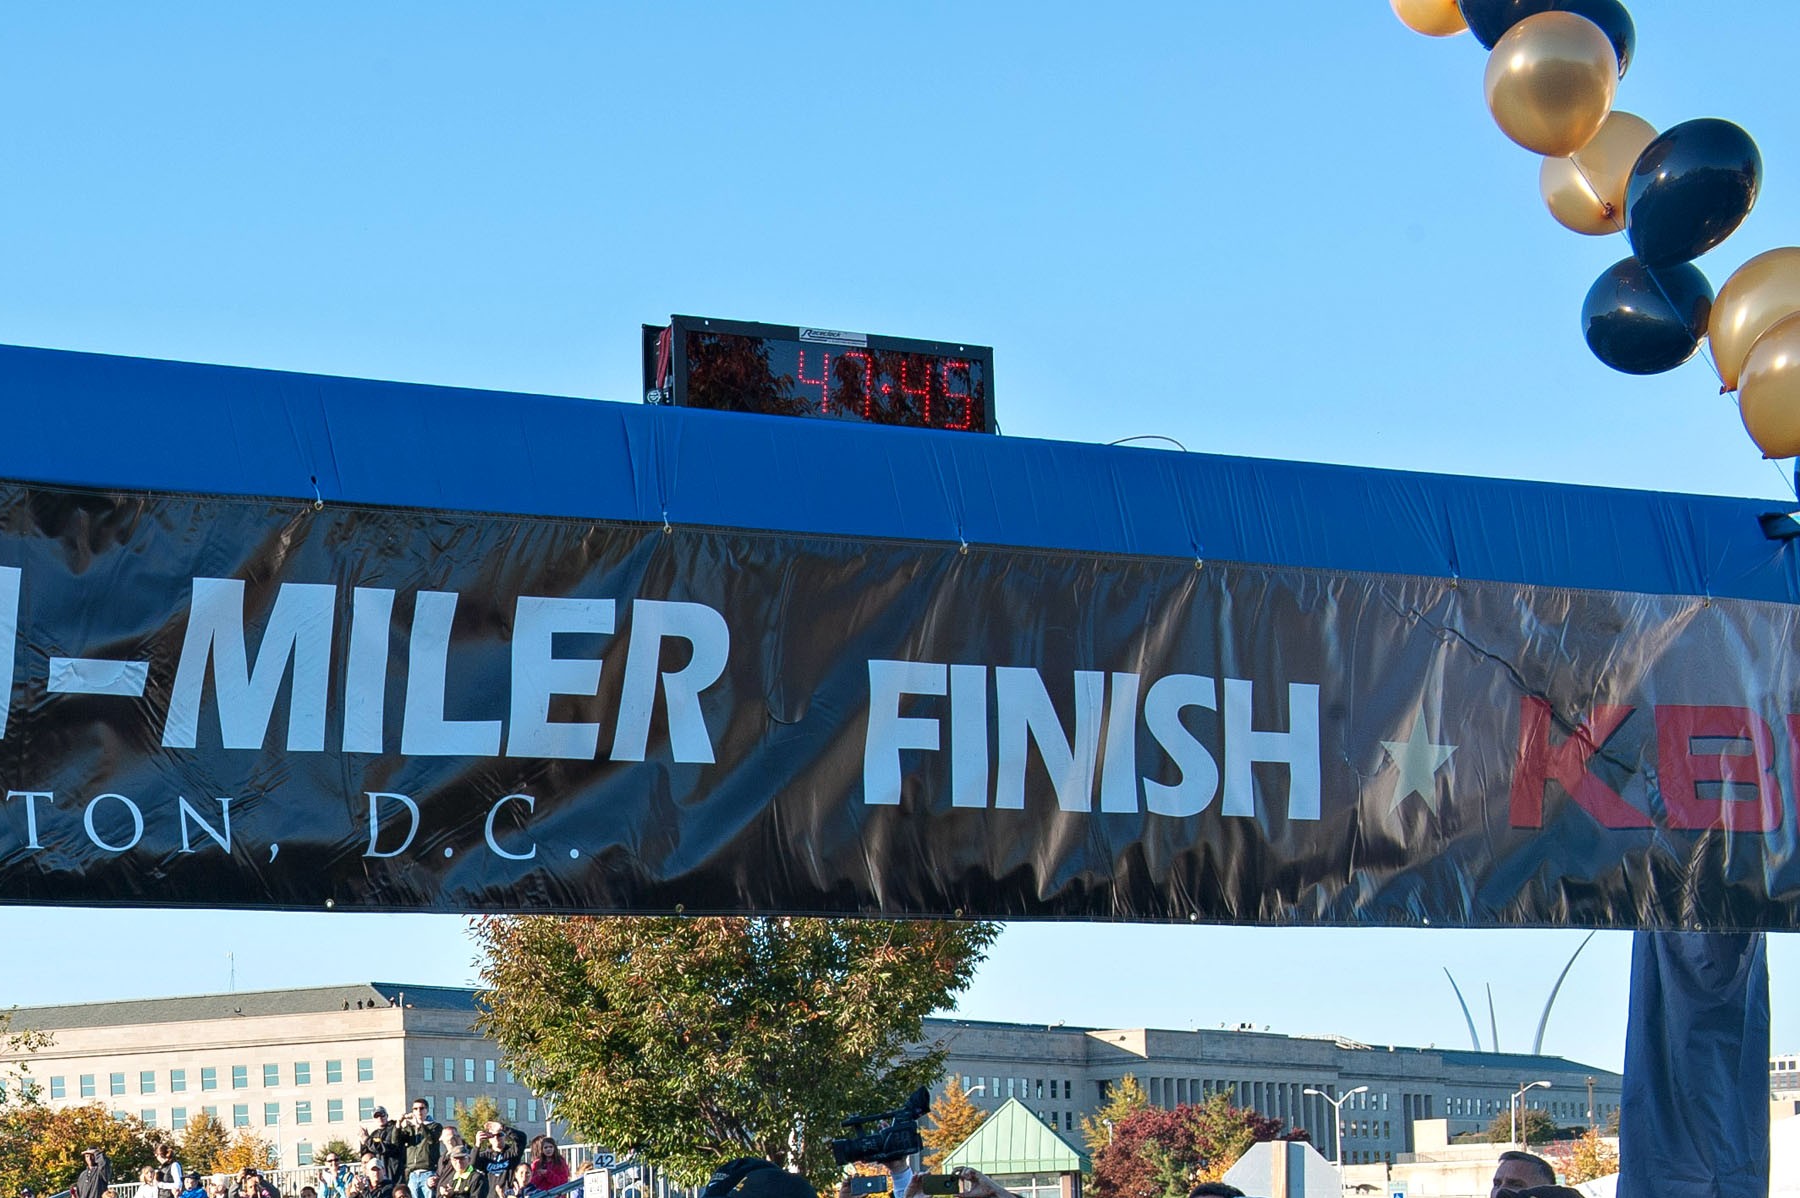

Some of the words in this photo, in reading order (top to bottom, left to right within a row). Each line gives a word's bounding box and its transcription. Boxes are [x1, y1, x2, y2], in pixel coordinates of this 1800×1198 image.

[864, 659, 1321, 821] FINISH
[364, 790, 582, 862] D.C.
[595, 1155, 614, 1167] 42
